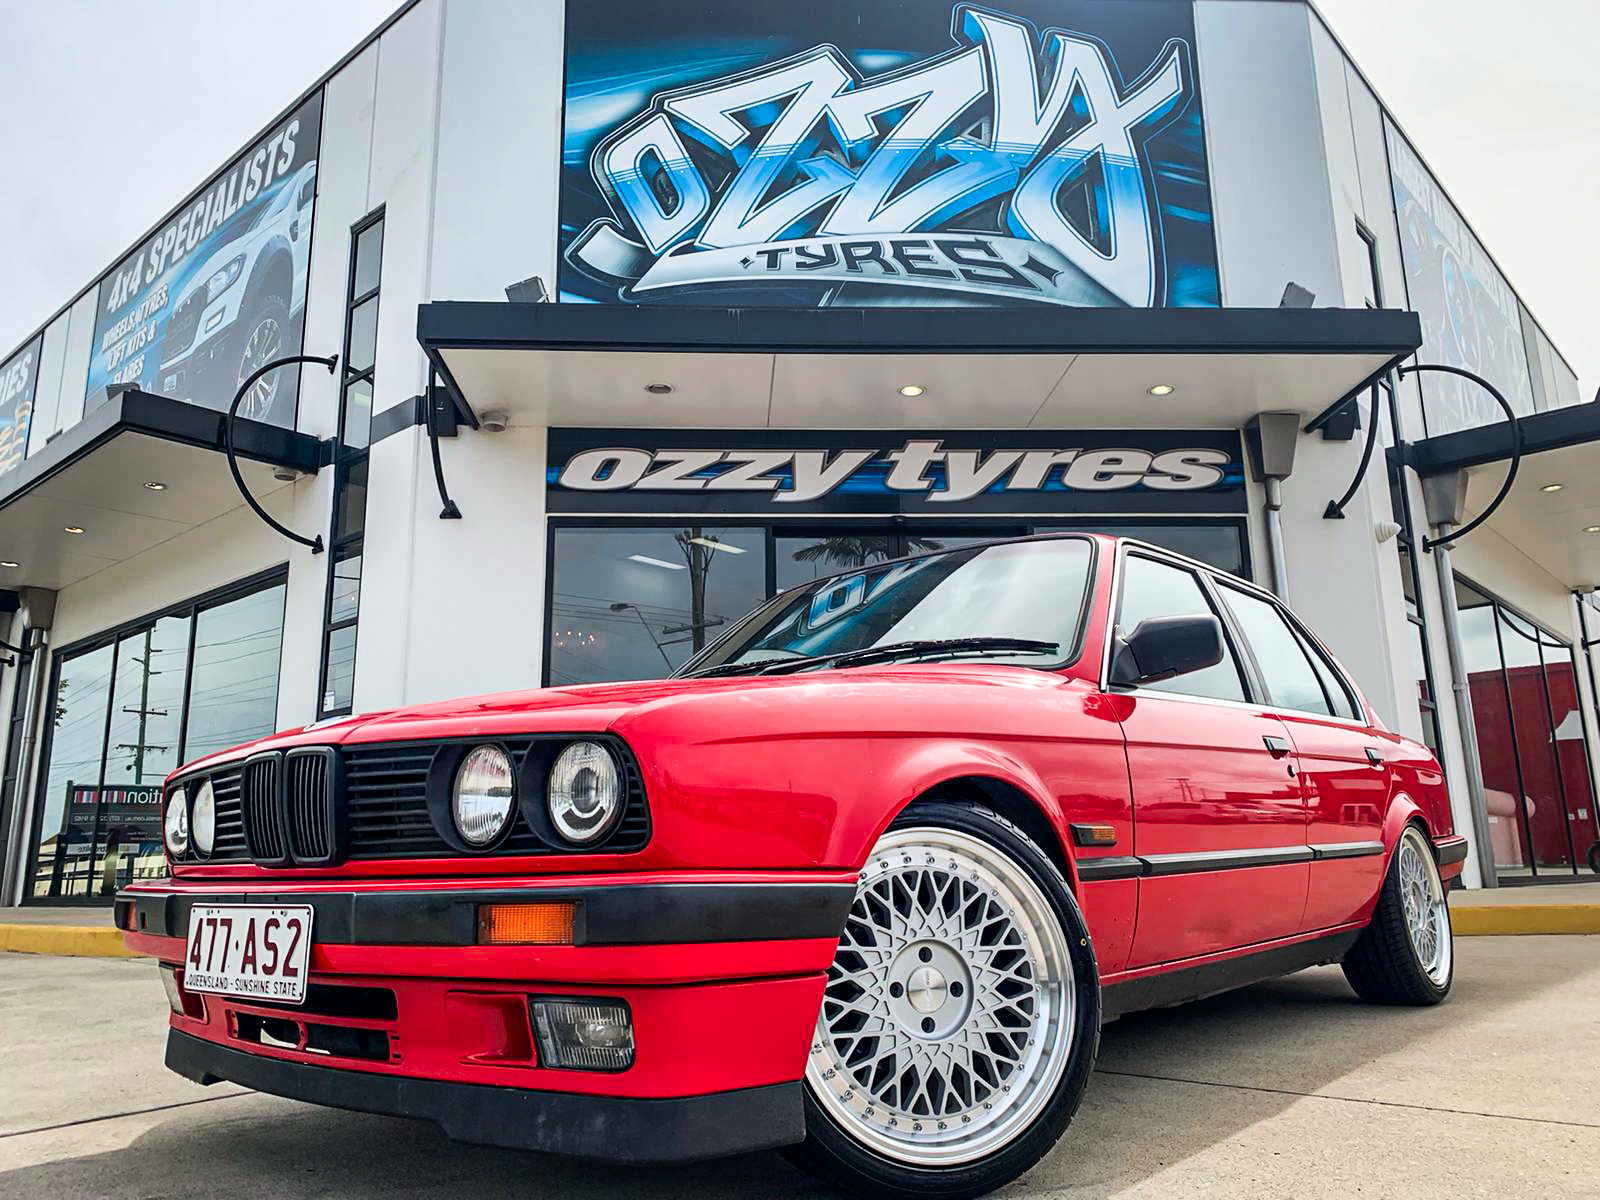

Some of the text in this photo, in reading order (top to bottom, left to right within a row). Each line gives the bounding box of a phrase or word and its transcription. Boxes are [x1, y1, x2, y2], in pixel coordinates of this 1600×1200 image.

[145, 119, 300, 284] SPECIALISTS
[756, 239, 1041, 291] TYRES
[188, 973, 228, 990] QUEENSLAND
[234, 977, 270, 994] SUNSHINE
[273, 981, 297, 997] STATE
